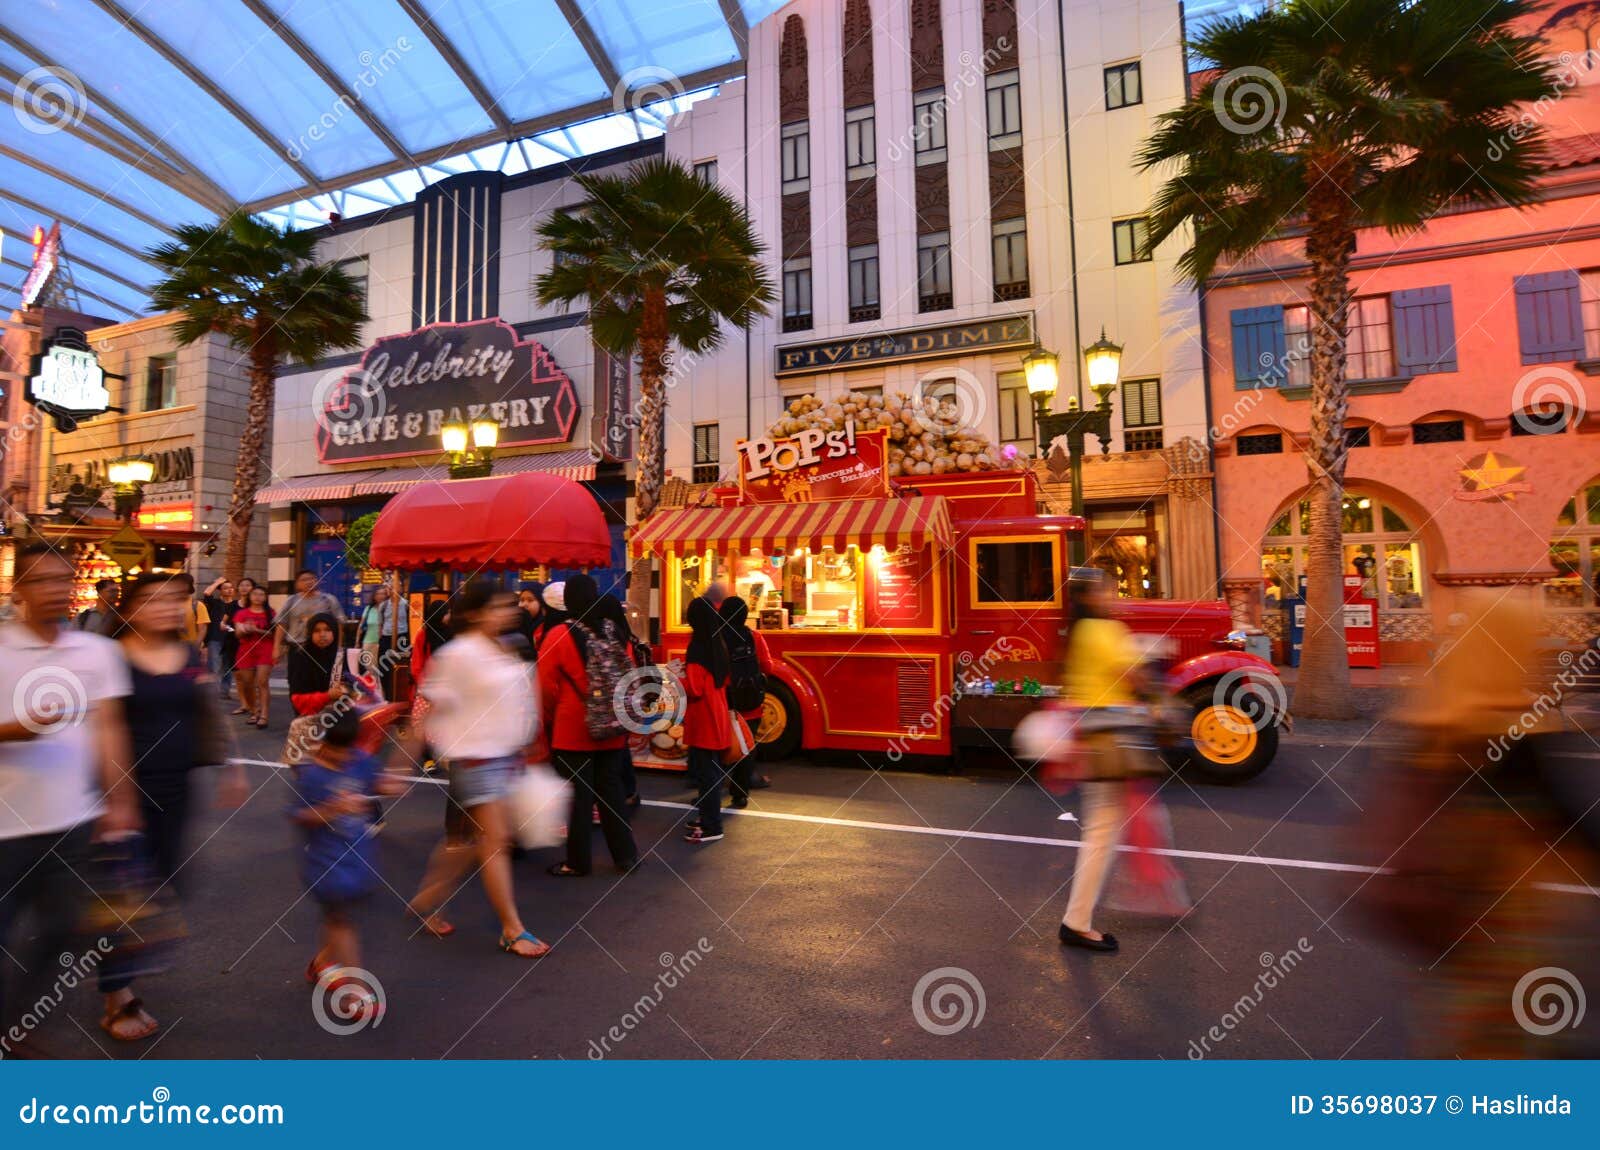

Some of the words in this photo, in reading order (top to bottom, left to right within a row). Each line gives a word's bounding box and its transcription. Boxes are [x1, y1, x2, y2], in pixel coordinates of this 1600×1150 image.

[783, 342, 872, 367] FIVE
[911, 323, 1023, 351] DIME
[361, 343, 515, 398] Celebrity
[332, 403, 399, 446] CAFÉ
[402, 412, 425, 439] &
[427, 396, 551, 437] BAKERY
